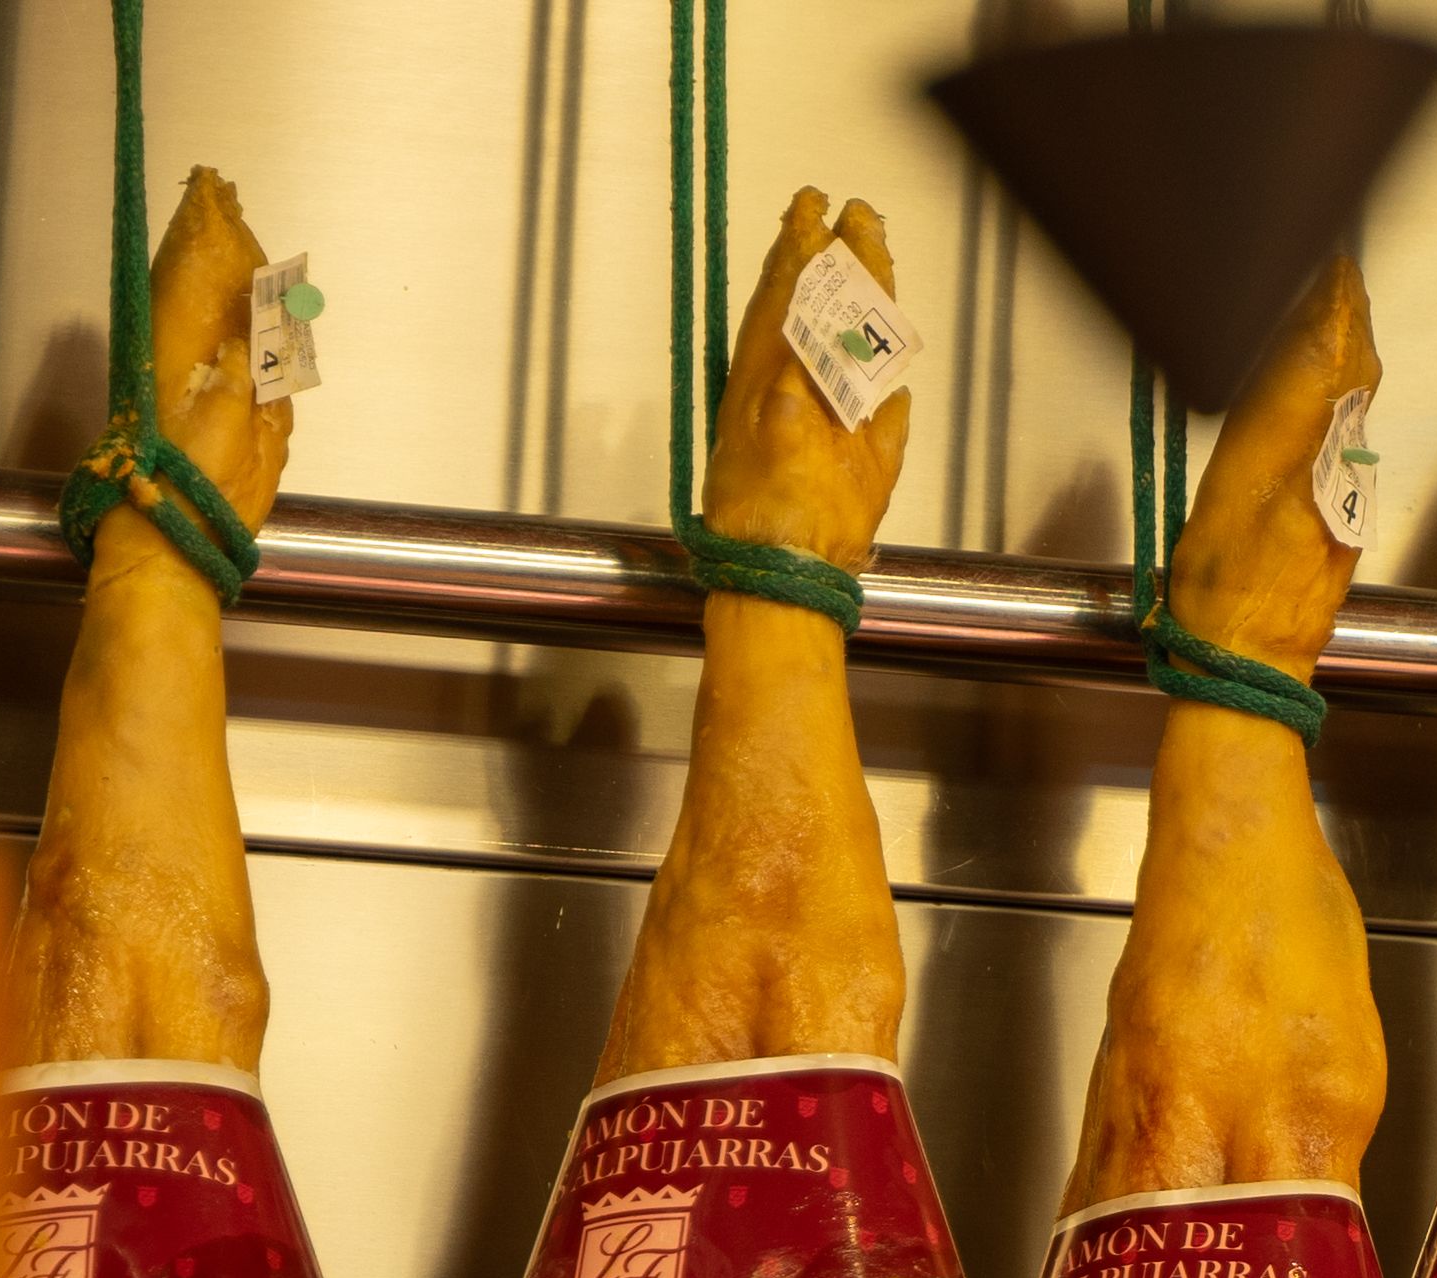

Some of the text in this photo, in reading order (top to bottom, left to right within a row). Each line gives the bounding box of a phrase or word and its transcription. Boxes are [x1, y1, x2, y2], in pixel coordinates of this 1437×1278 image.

[104, 1101, 172, 1134] DE
[576, 1096, 765, 1157] AMÓN DE
[15, 1139, 237, 1186] PUJARRAS
[570, 1137, 830, 1194] ALPUJARRAS
[1062, 1219, 1244, 1275] AMÓN DE
